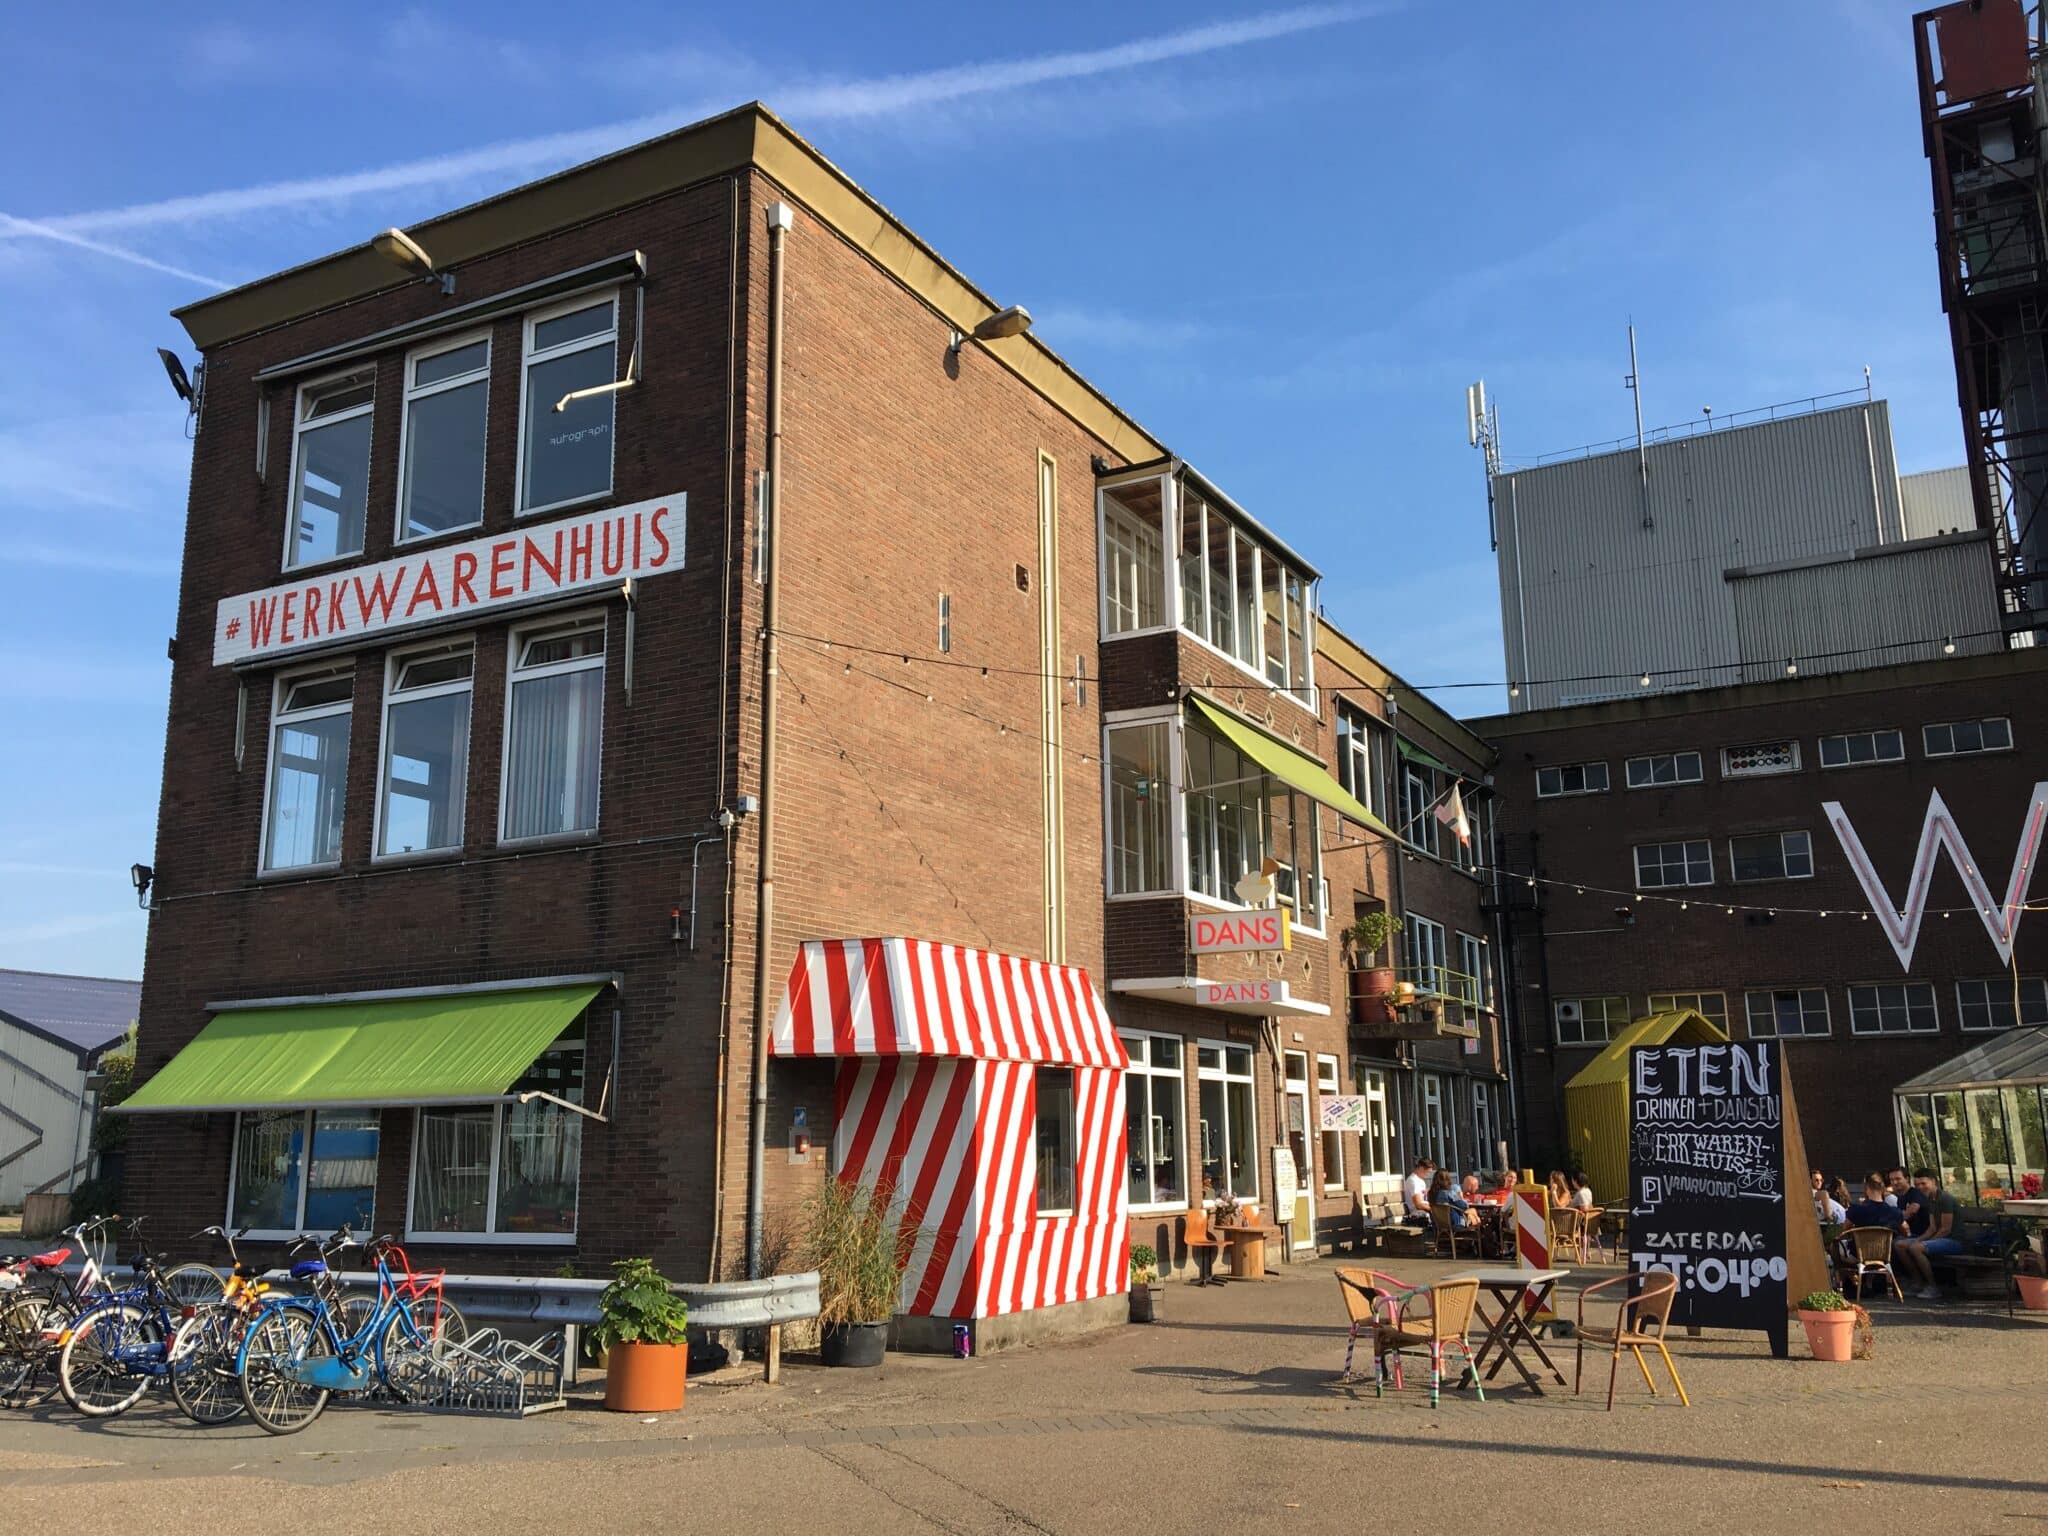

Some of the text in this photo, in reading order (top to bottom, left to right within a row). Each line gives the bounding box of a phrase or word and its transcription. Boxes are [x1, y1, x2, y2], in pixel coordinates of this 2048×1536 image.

[1821, 781, 2048, 974] W
[1197, 917, 1278, 946] DANS
[1209, 982, 1270, 1002] DANS
[1636, 1043, 1770, 1096] ETEN
[1636, 1097, 1695, 1121] DRINKEN
[1715, 1094, 1780, 1121] DANSEN
[1692, 1151, 1747, 1174] HUIS
[1646, 1175, 1738, 1198] P VANAVOND
[1645, 1231, 1766, 1252] ZATERDAG
